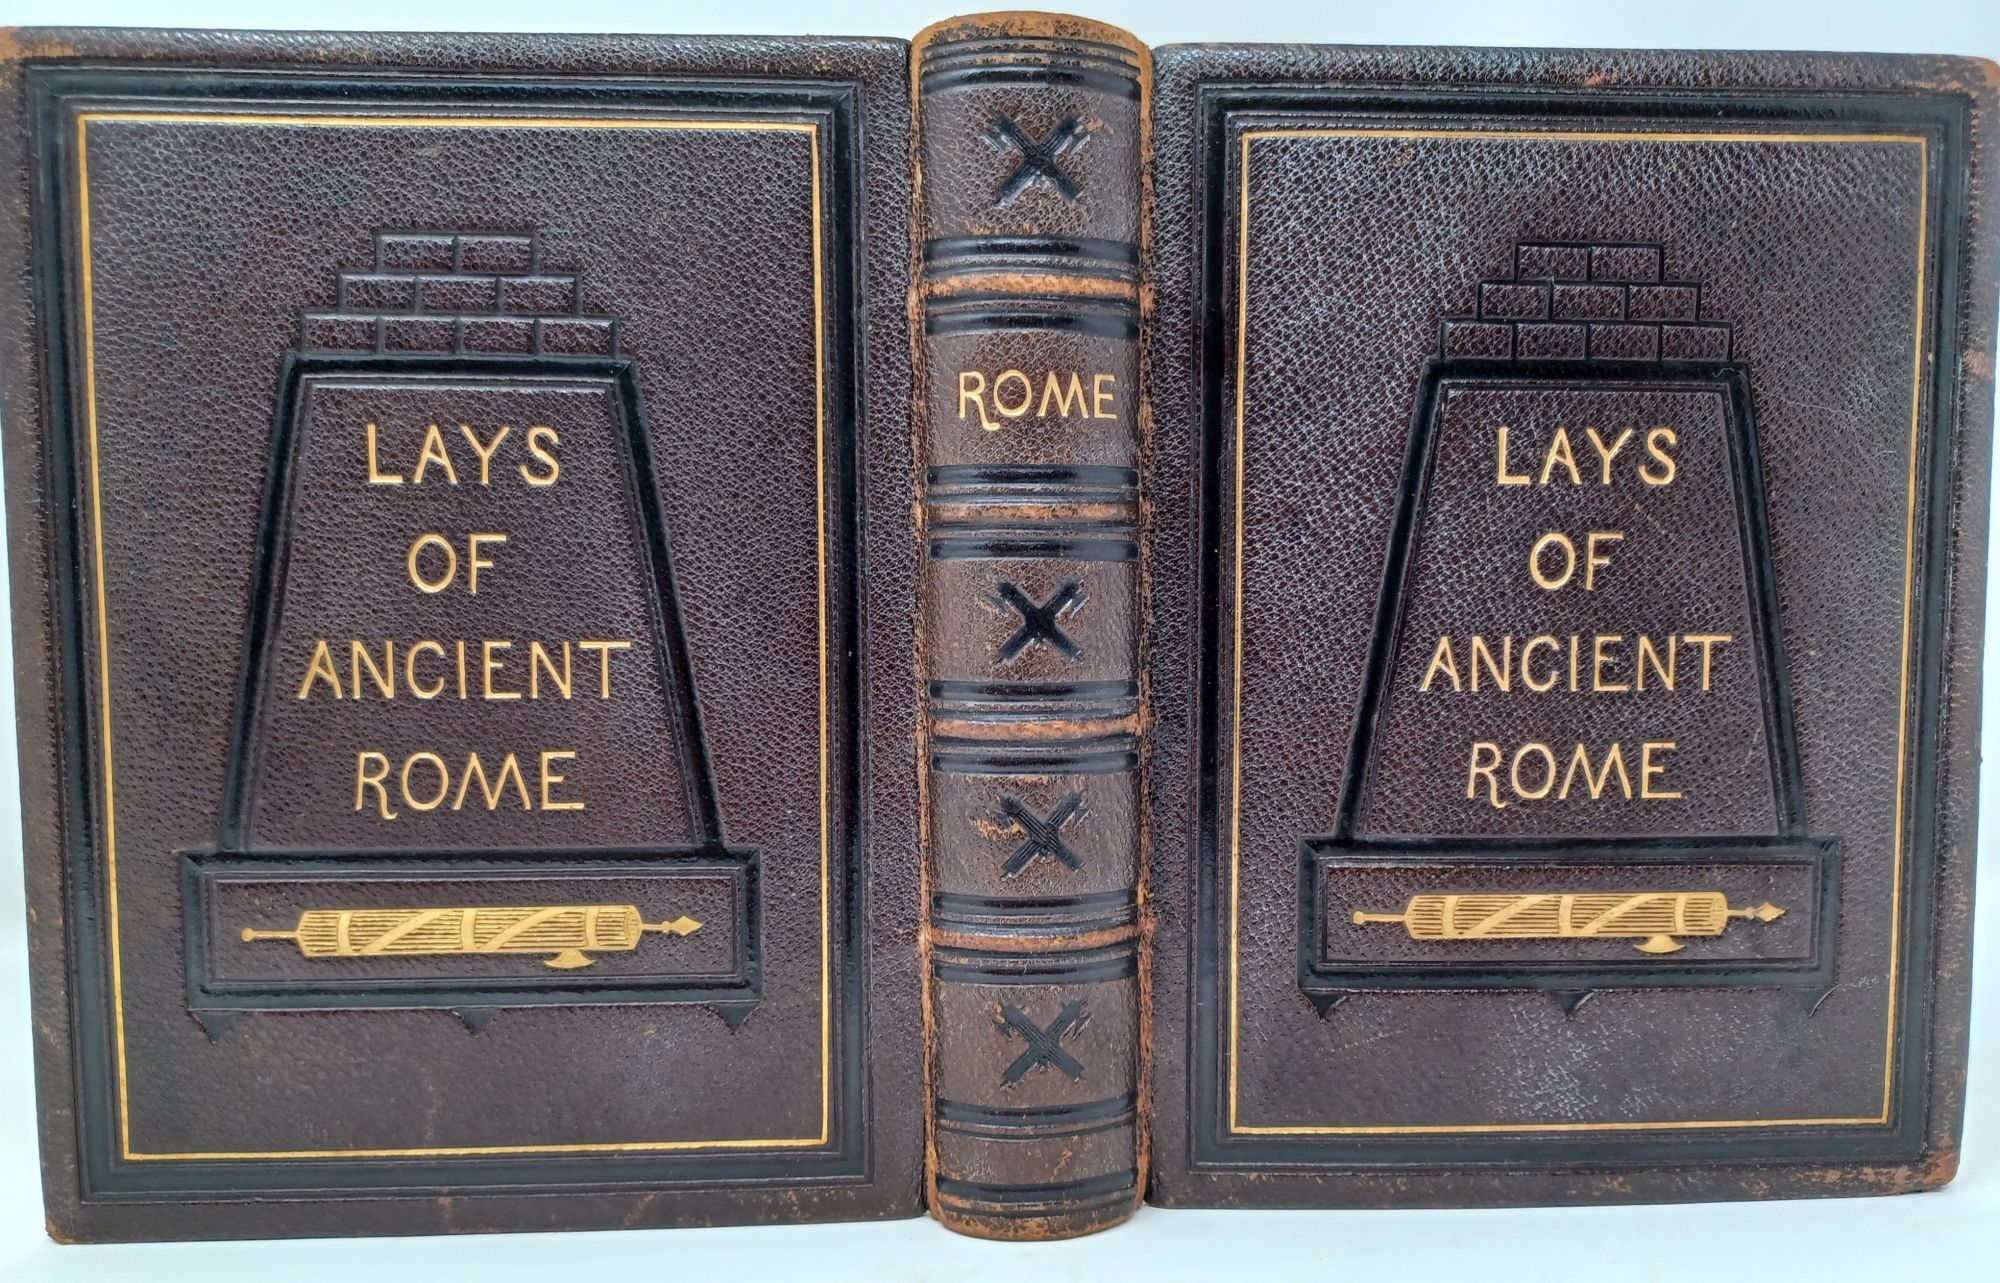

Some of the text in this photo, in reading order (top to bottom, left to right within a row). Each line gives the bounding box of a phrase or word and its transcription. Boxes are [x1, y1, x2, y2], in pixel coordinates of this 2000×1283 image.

[958, 369, 1117, 432] ROME
[367, 423, 560, 485] LAYS
[1497, 427, 1678, 486] LAYS
[408, 533, 507, 593] OF
[1529, 532, 1624, 590] OF
[298, 640, 632, 699] ANCIENT
[1420, 635, 1733, 693] ANCIENT
[356, 751, 586, 819] ROME
[1467, 742, 1683, 808] ROME
